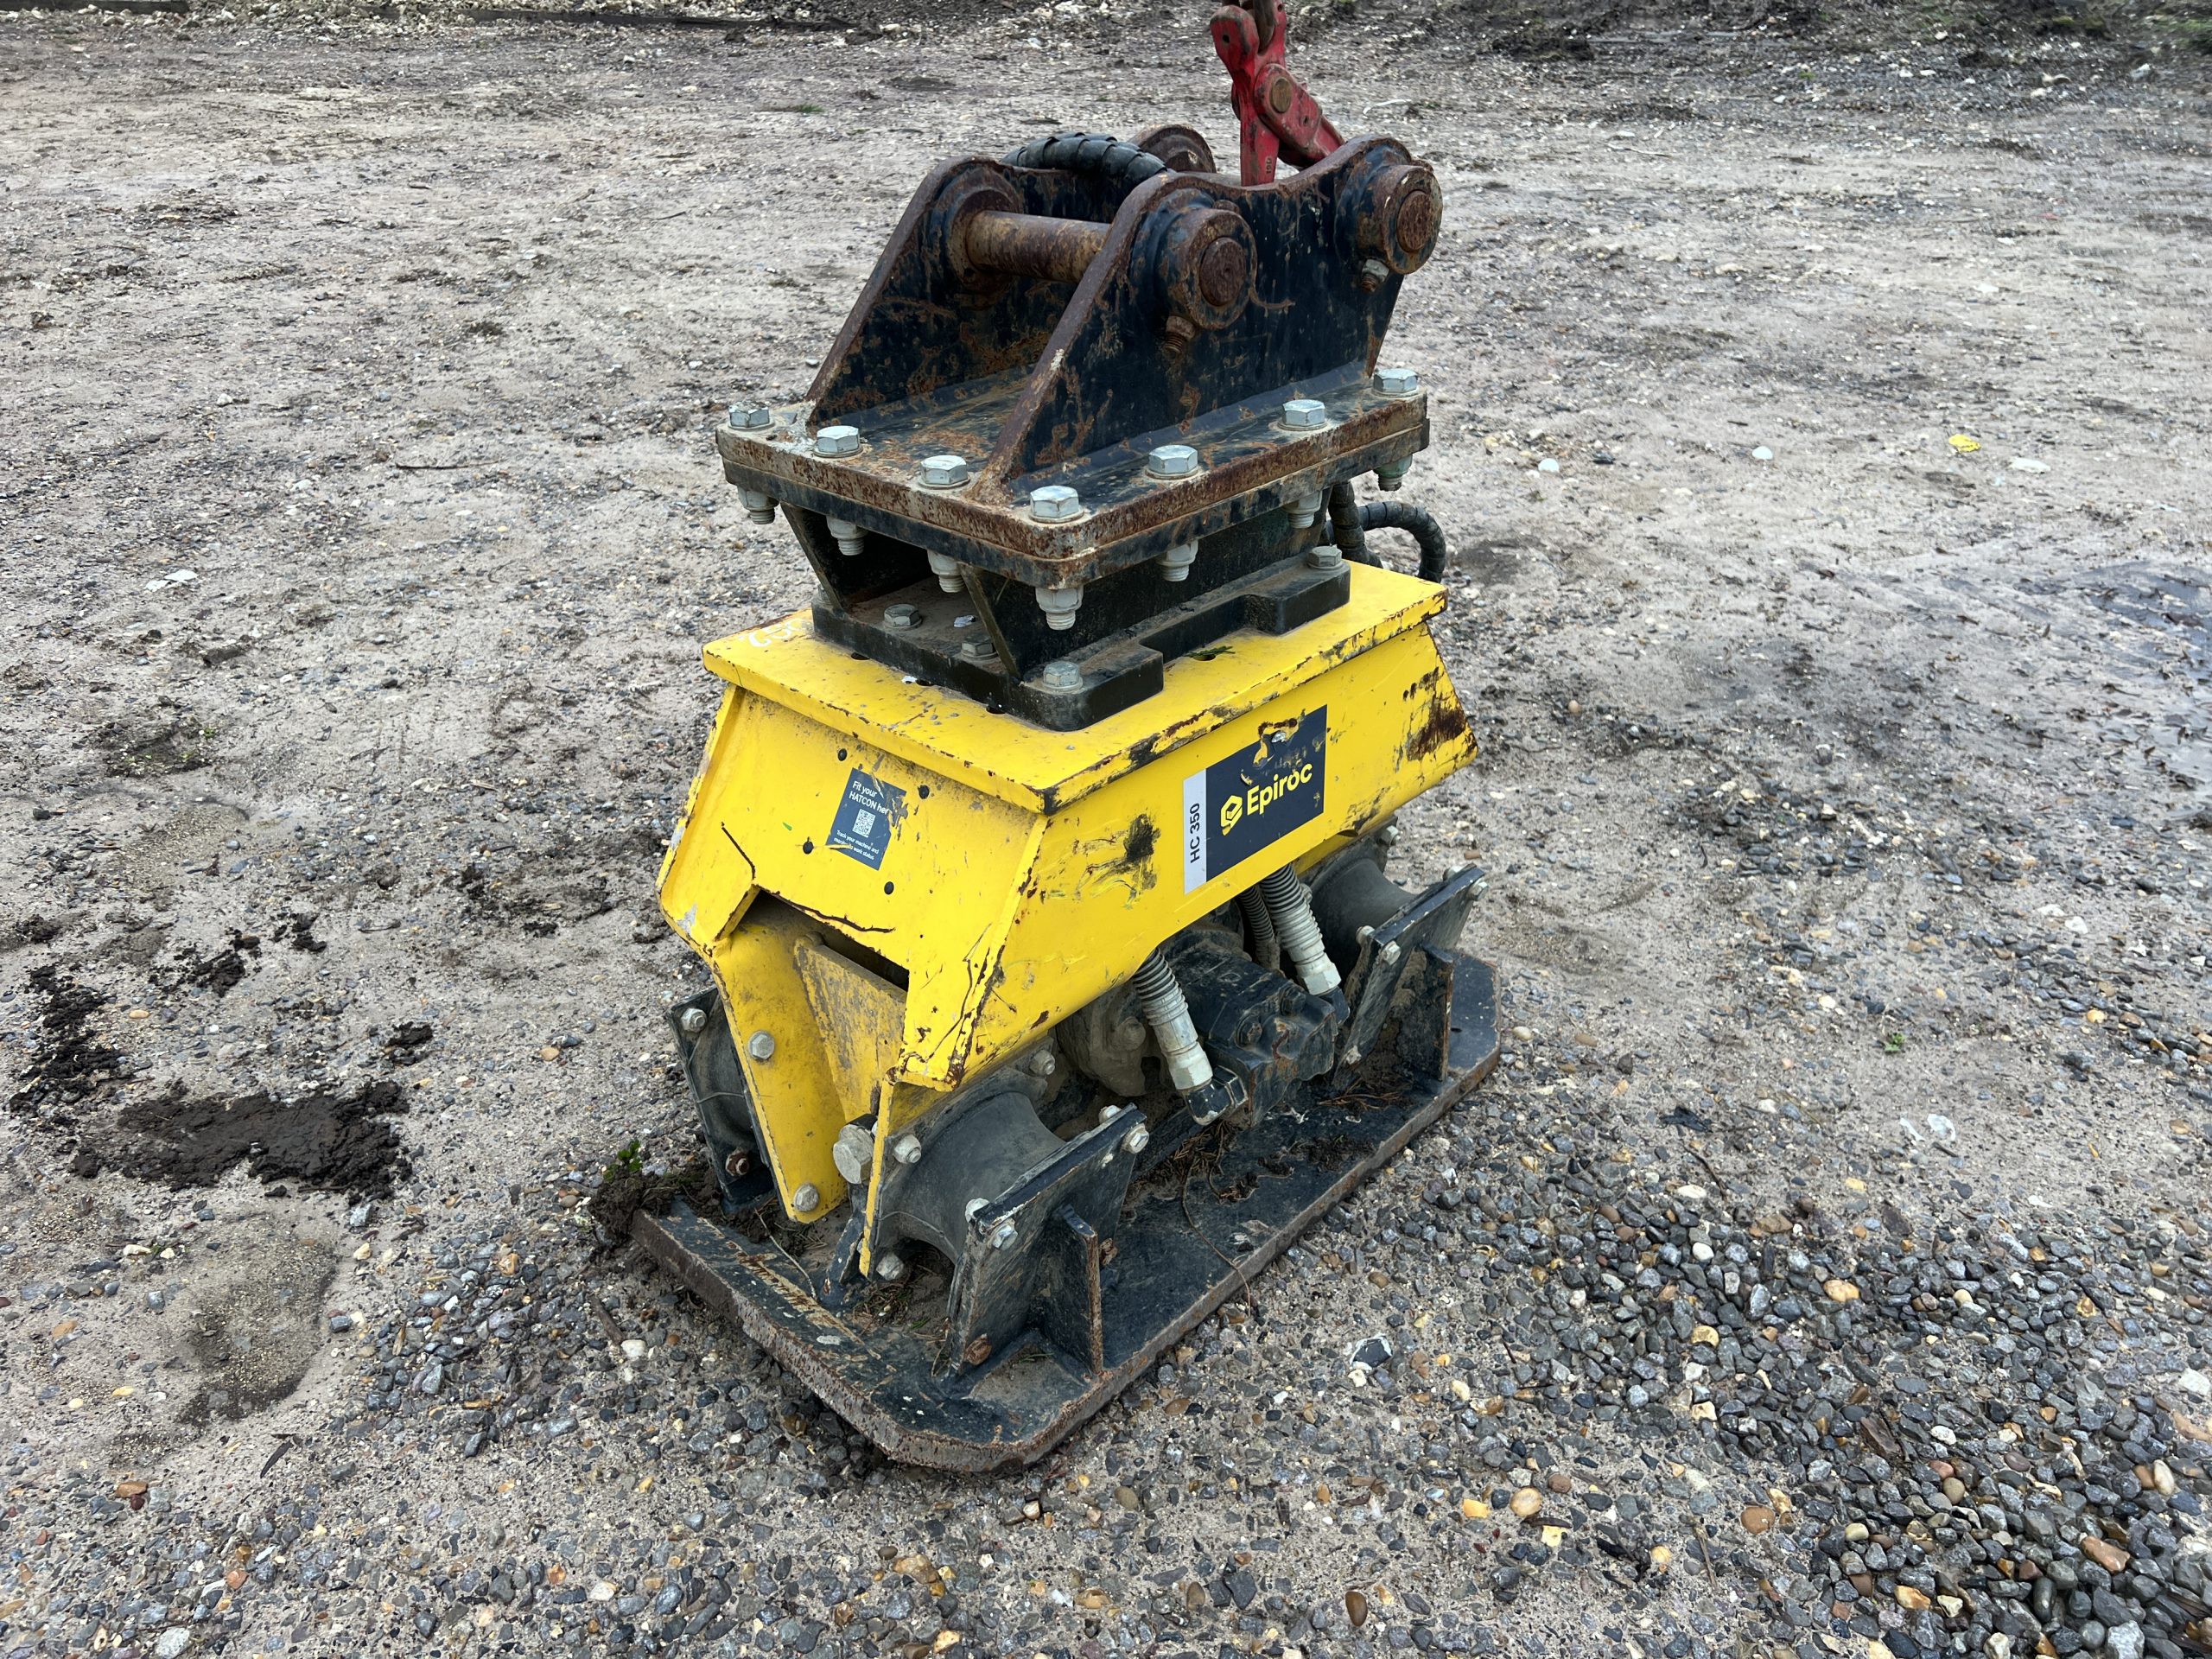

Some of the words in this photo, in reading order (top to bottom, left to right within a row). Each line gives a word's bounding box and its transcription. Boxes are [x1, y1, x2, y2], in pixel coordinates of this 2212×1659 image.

[861, 785, 877, 798] your
[1247, 764, 1313, 815] Epiroc
[849, 791, 877, 810] HATCON
[877, 804, 892, 815] her
[1190, 803, 1200, 834] 350
[855, 840, 871, 851] machine
[1190, 836, 1200, 864] HC
